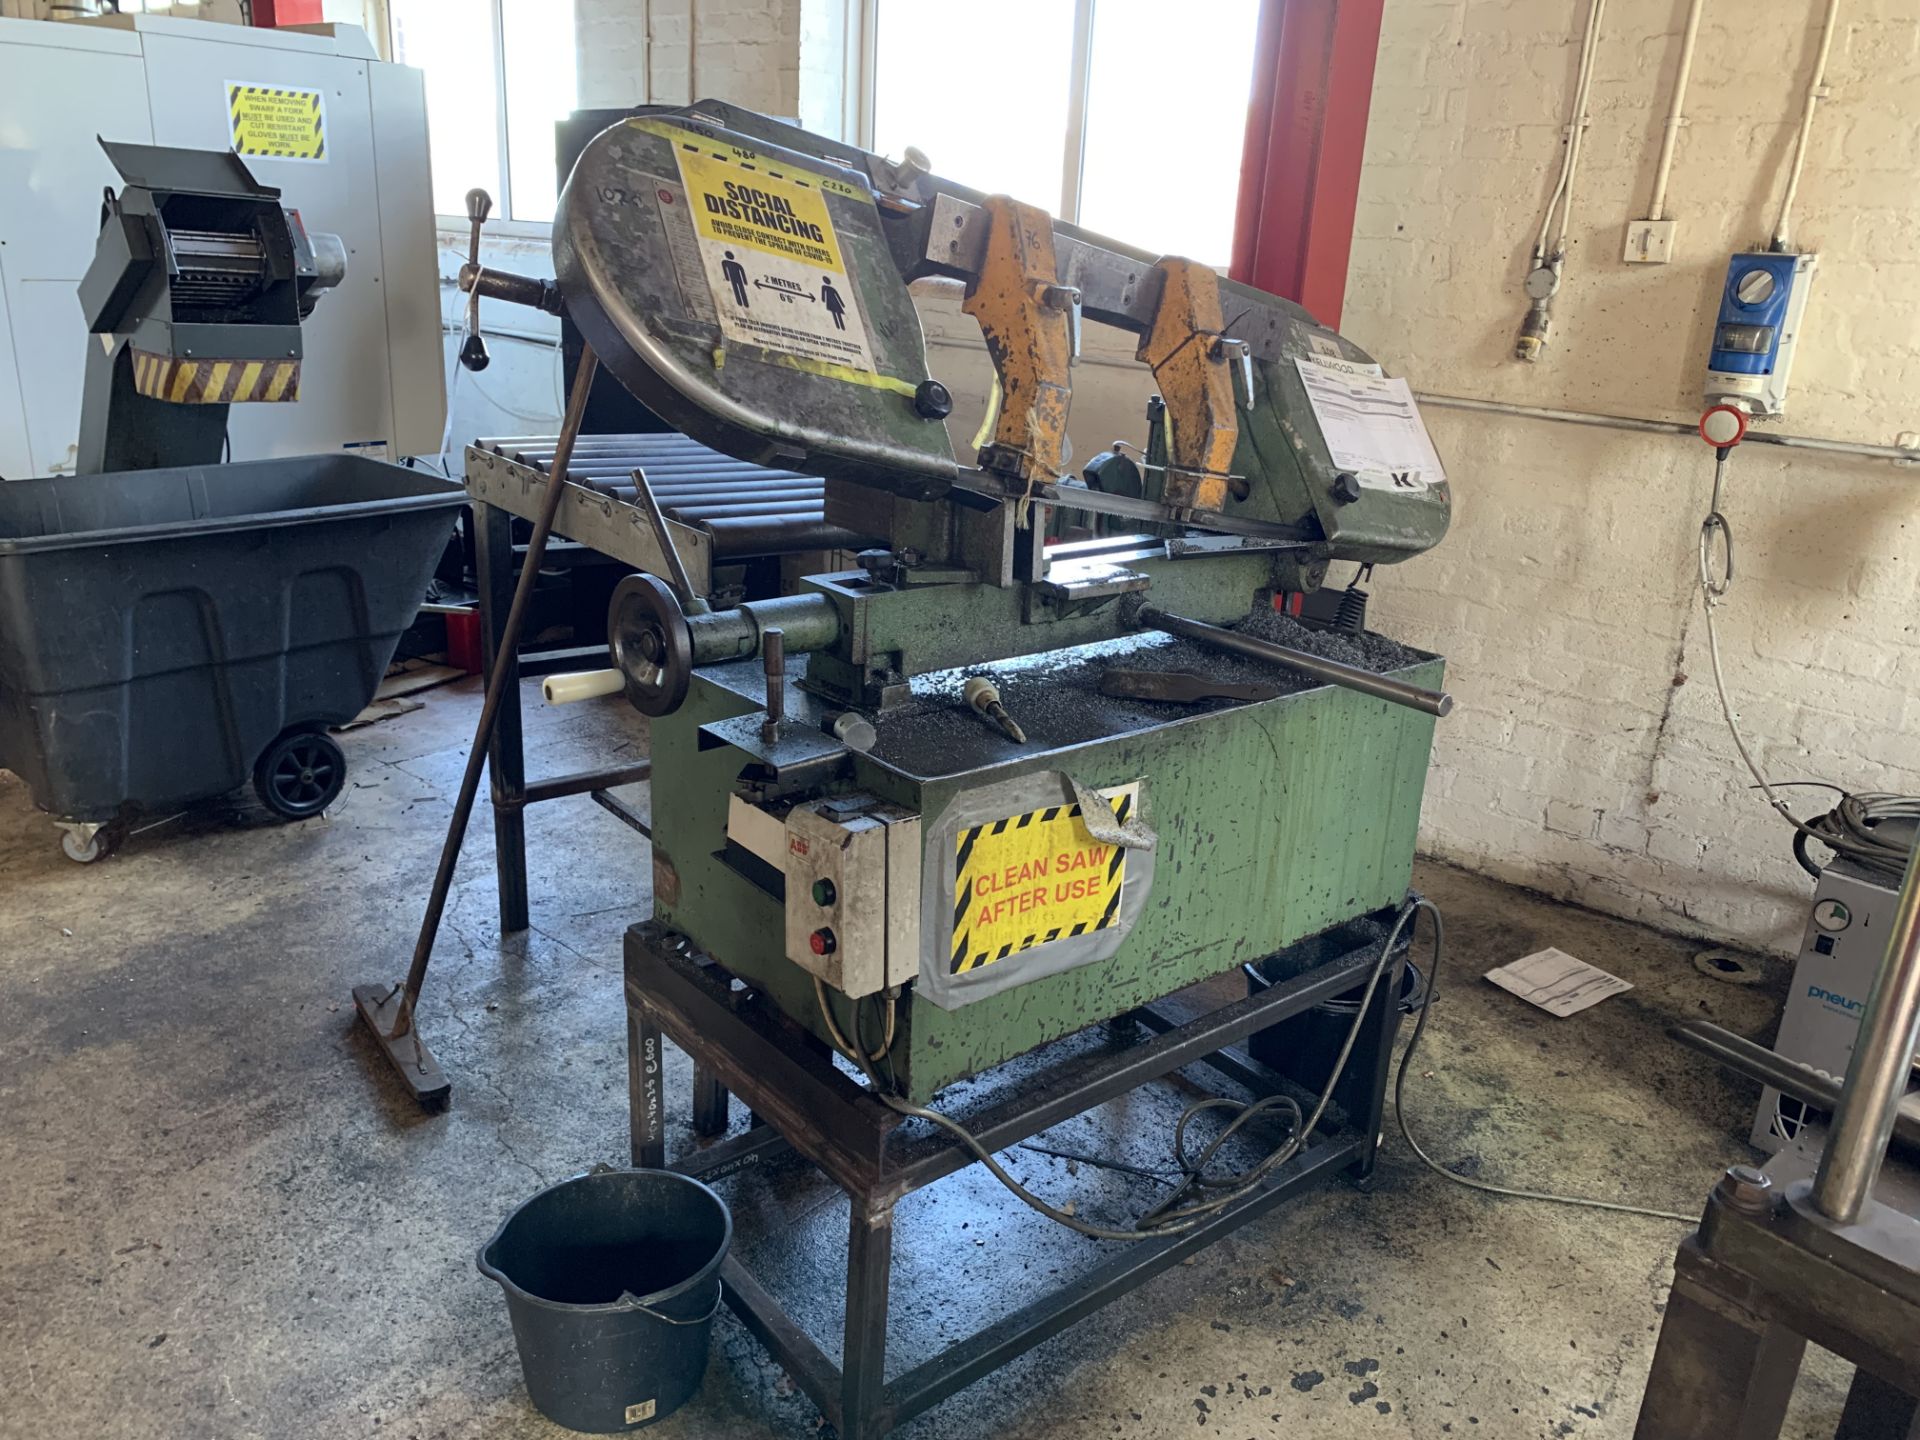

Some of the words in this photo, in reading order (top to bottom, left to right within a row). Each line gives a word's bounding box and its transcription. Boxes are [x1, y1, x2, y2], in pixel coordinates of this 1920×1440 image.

[268, 97, 306, 106] REMOVING
[242, 112, 262, 121] MUST
[276, 115, 296, 123] USED
[279, 133, 299, 142] MUST
[723, 180, 796, 217] SOCIAL
[703, 192, 825, 244] DISTANCING
[711, 218, 733, 230] AVOID
[734, 224, 754, 237] CLOSE
[756, 230, 786, 244] CONTACT
[787, 239, 805, 250] WITH
[806, 244, 830, 258] OTHERS
[712, 225, 722, 234] TO
[723, 228, 753, 242] PREVENT
[755, 236, 767, 247] THE
[768, 240, 794, 253] SPREAD
[764, 274, 770, 283] 2
[771, 276, 802, 291] METRES
[790, 838, 808, 856] ABB
[975, 857, 1048, 897] CLEAN
[1055, 845, 1109, 874] SAW
[976, 887, 1047, 928] AFTER
[1055, 876, 1101, 903] USE
